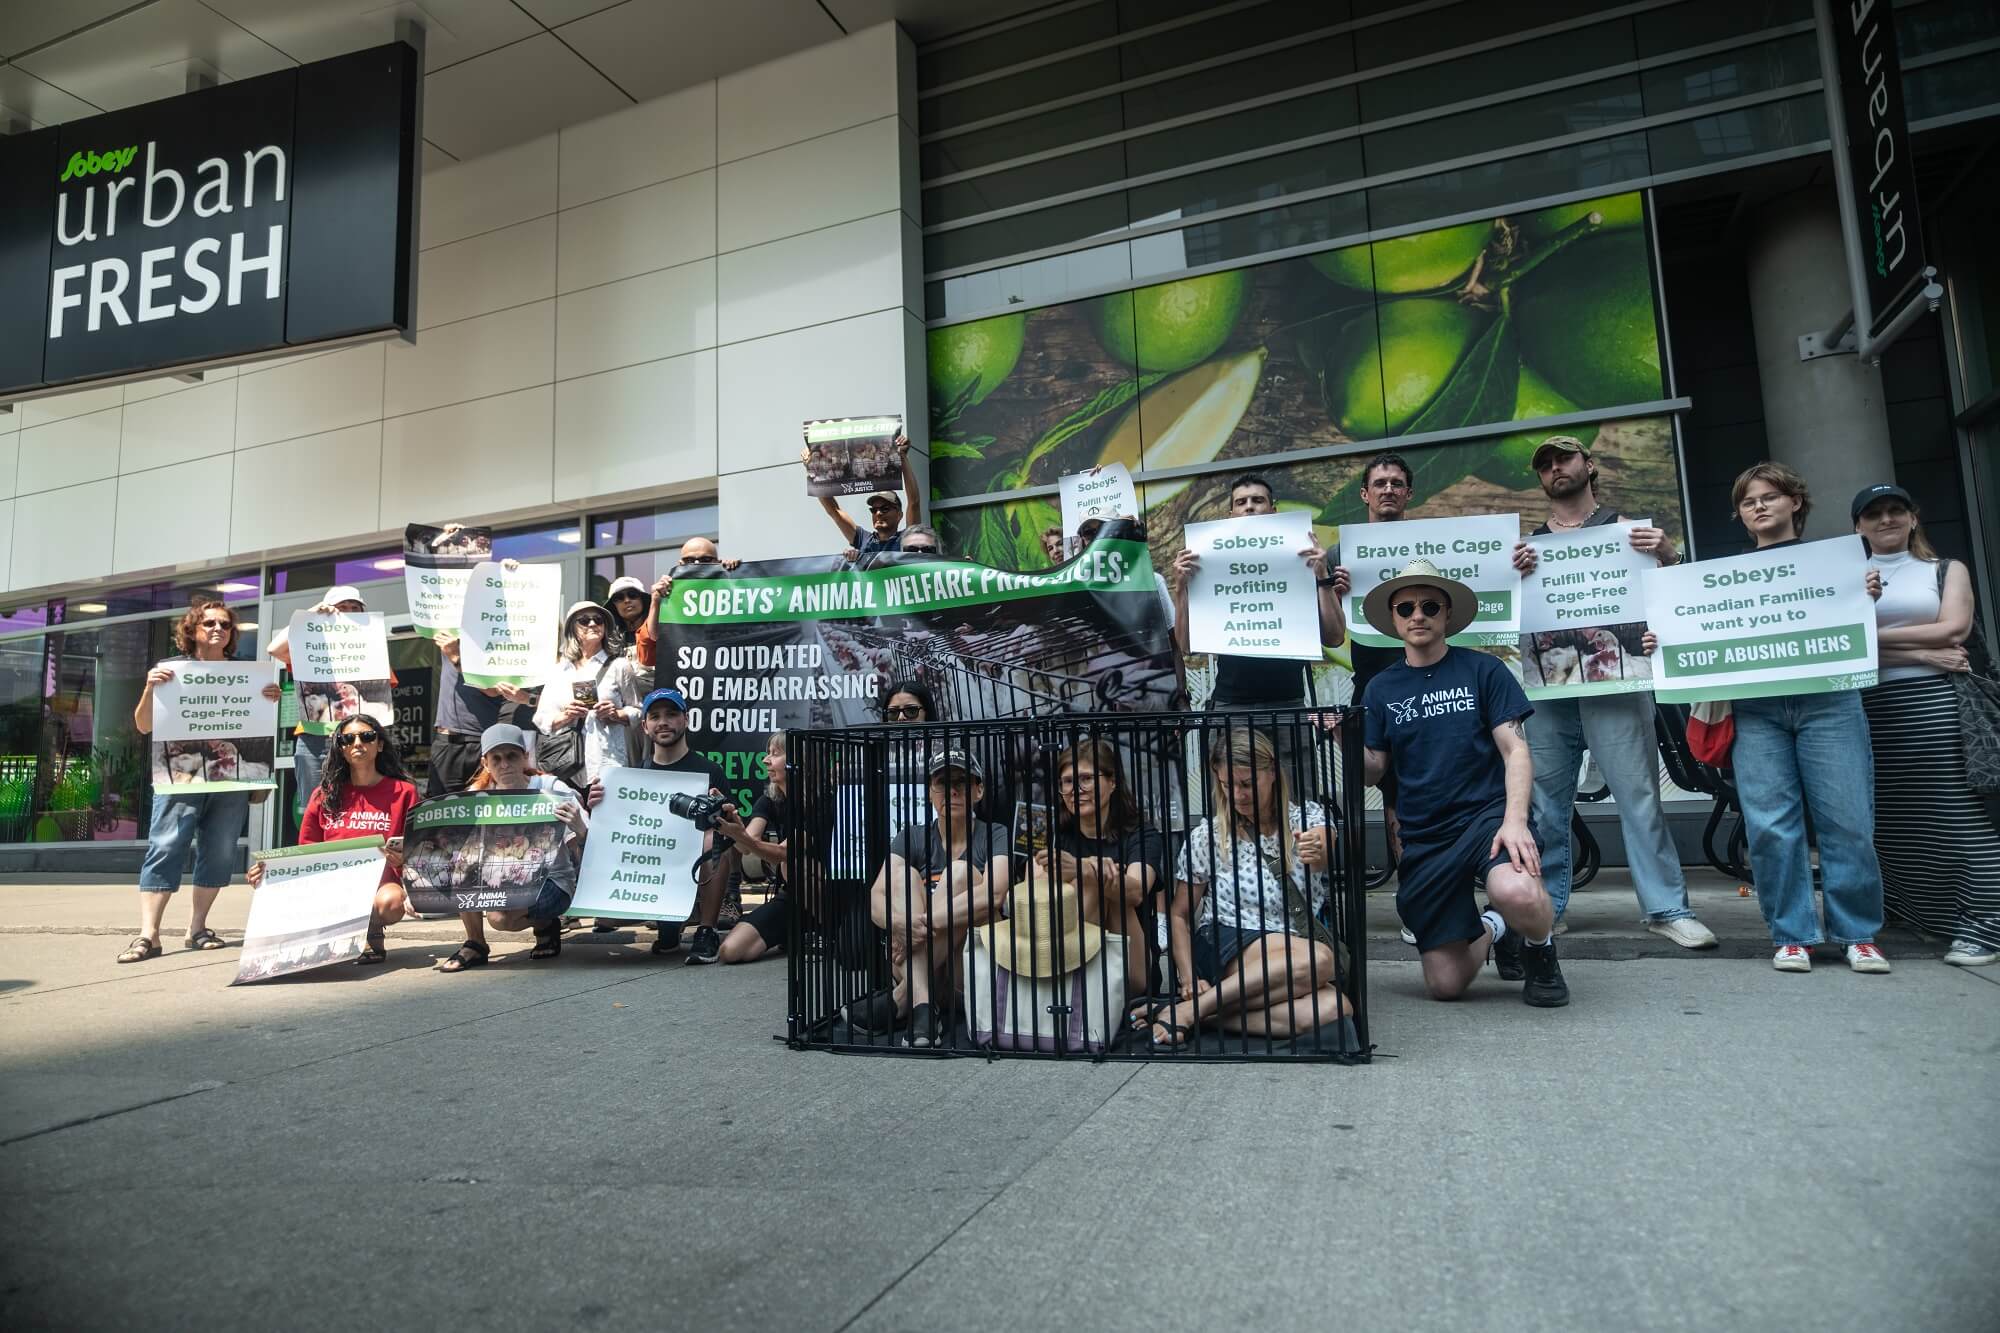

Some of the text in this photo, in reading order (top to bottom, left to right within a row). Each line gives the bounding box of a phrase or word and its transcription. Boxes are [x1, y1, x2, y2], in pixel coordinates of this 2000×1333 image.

[1863, 24, 1906, 272] urban
[61, 145, 138, 182] Sobeys
[57, 141, 286, 246] urban
[50, 224, 283, 338] FRESH
[1077, 475, 1118, 493] Sobeys:
[1077, 497, 1101, 508] Fulfill
[1103, 492, 1122, 502] Your
[1212, 535, 1285, 551] Sobeys:
[1356, 539, 1502, 559] Brave the Cage
[1542, 539, 1621, 564] Sobeys:
[1229, 562, 1269, 576] Stop
[1379, 564, 1479, 581] Chnge!
[1541, 566, 1628, 588] Fulfill Your
[1702, 562, 1796, 590] Sobeys:
[789, 581, 876, 613] ANIMAL
[885, 568, 974, 606] WELFARE
[1214, 579, 1288, 597] Profiting
[1546, 584, 1628, 604] Cage-Free
[1229, 601, 1274, 614] From
[1478, 601, 1504, 614] Cage
[1674, 585, 1836, 617] Canadian Families
[1556, 603, 1621, 620] Promise
[1700, 608, 1806, 632] want you to
[306, 622, 362, 634] Sobeys:
[492, 627, 525, 636] From
[1223, 618, 1283, 633] Animal
[305, 641, 367, 651] Fulfill Your
[485, 641, 530, 651] Animal
[1228, 635, 1281, 647] Abuse
[307, 652, 366, 664] Cage-Free
[677, 644, 822, 671] SO OUTDATED
[1677, 634, 1851, 669] STOP ABUSING HENS
[314, 665, 361, 675] Promise
[488, 657, 527, 666] Abuse
[183, 672, 249, 687] Sobeys:
[676, 674, 879, 701] SO EMBARRASSING
[179, 695, 252, 705] Fulfill Your
[1421, 686, 1473, 704] ANIMAL
[181, 708, 250, 719] Cage-Free
[1422, 698, 1475, 719] JUSTICE
[188, 721, 243, 732] Promise
[710, 708, 781, 732] CRUEL
[350, 811, 391, 822] ANIMAL
[416, 801, 560, 824] SOBEYS: GO CAGE-FREE
[346, 819, 391, 831] JUSTICE
[628, 814, 663, 829] Stop
[611, 831, 677, 850] Profiting
[621, 851, 662, 866] From
[265, 862, 339, 879] Cage-Free!
[611, 869, 666, 886] Animal
[475, 899, 507, 909] JUSTICE
[477, 891, 507, 900] ANIMAL
[608, 888, 659, 903] Abuse
